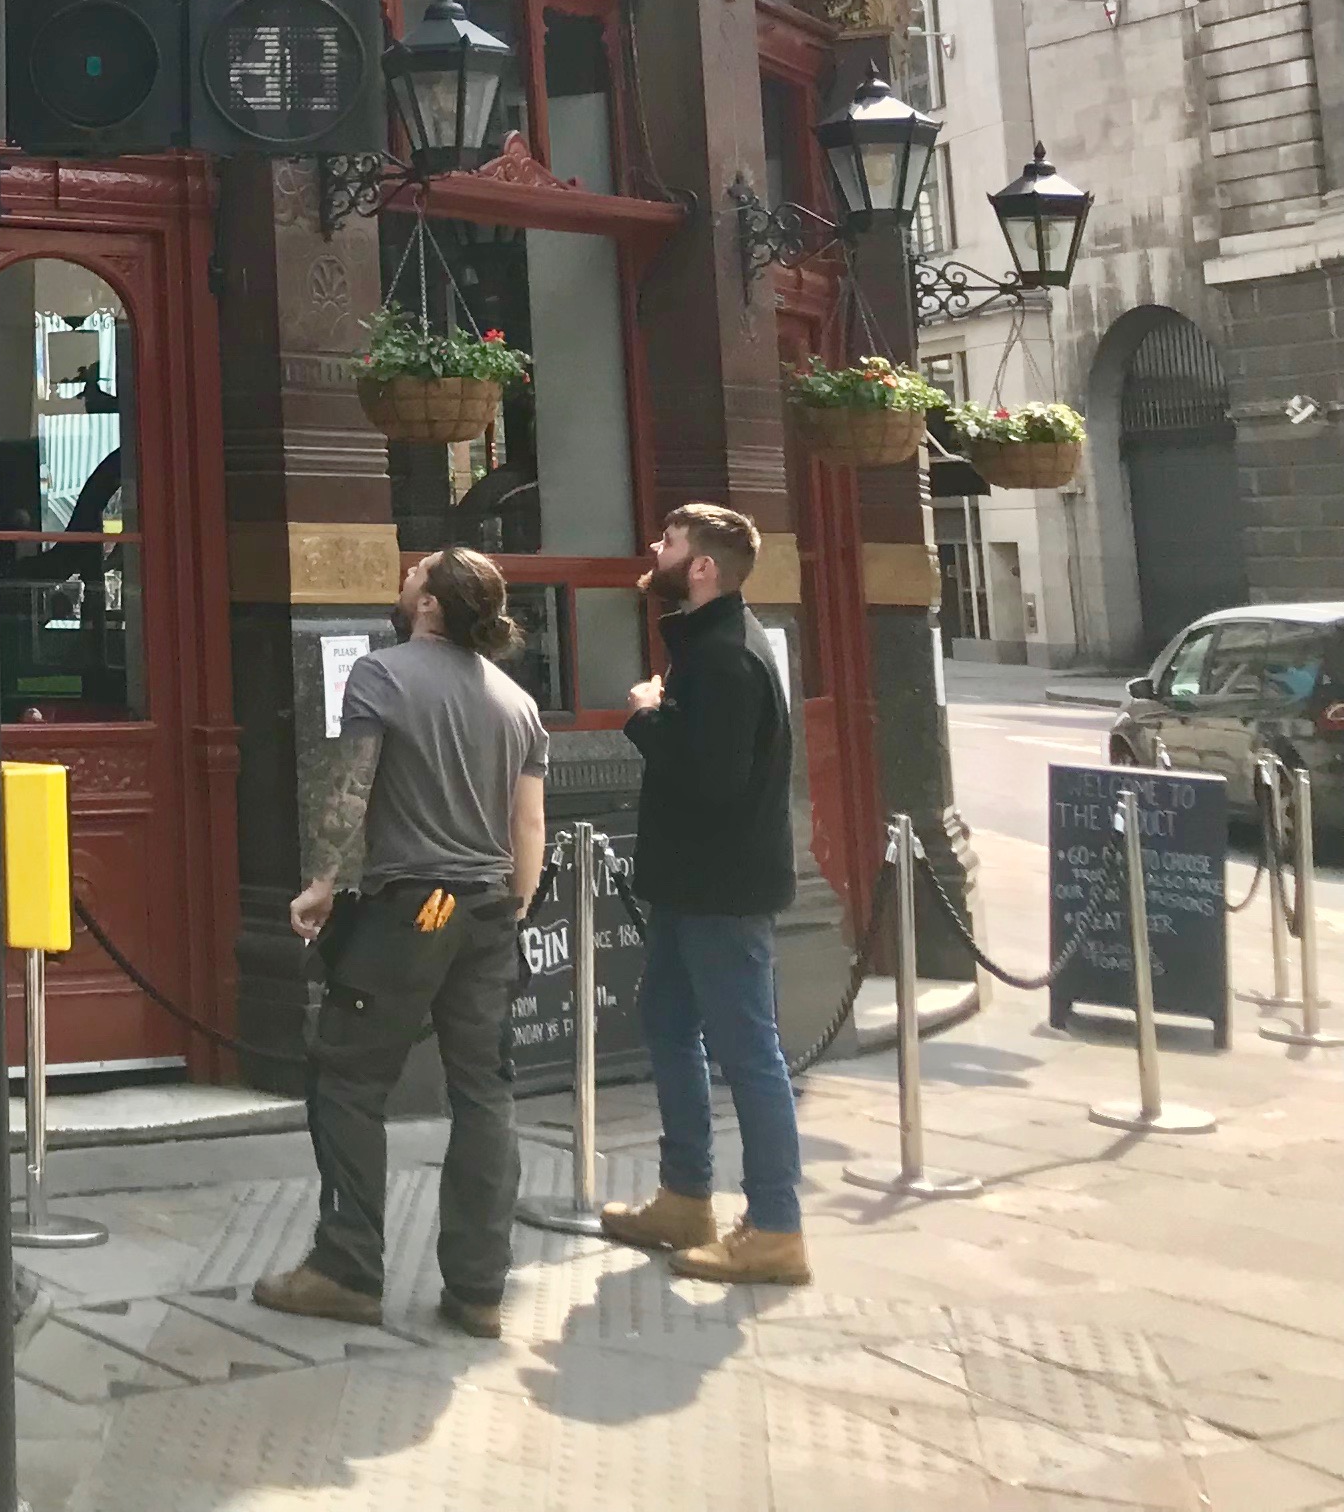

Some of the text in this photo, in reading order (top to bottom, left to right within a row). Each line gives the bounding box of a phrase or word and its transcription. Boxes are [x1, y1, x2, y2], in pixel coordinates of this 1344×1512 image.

[333, 647, 358, 657] PLEASE
[1166, 781, 1197, 810] TO
[1055, 801, 1102, 831] THE
[616, 923, 644, 948] 186
[519, 926, 570, 975] GIN
